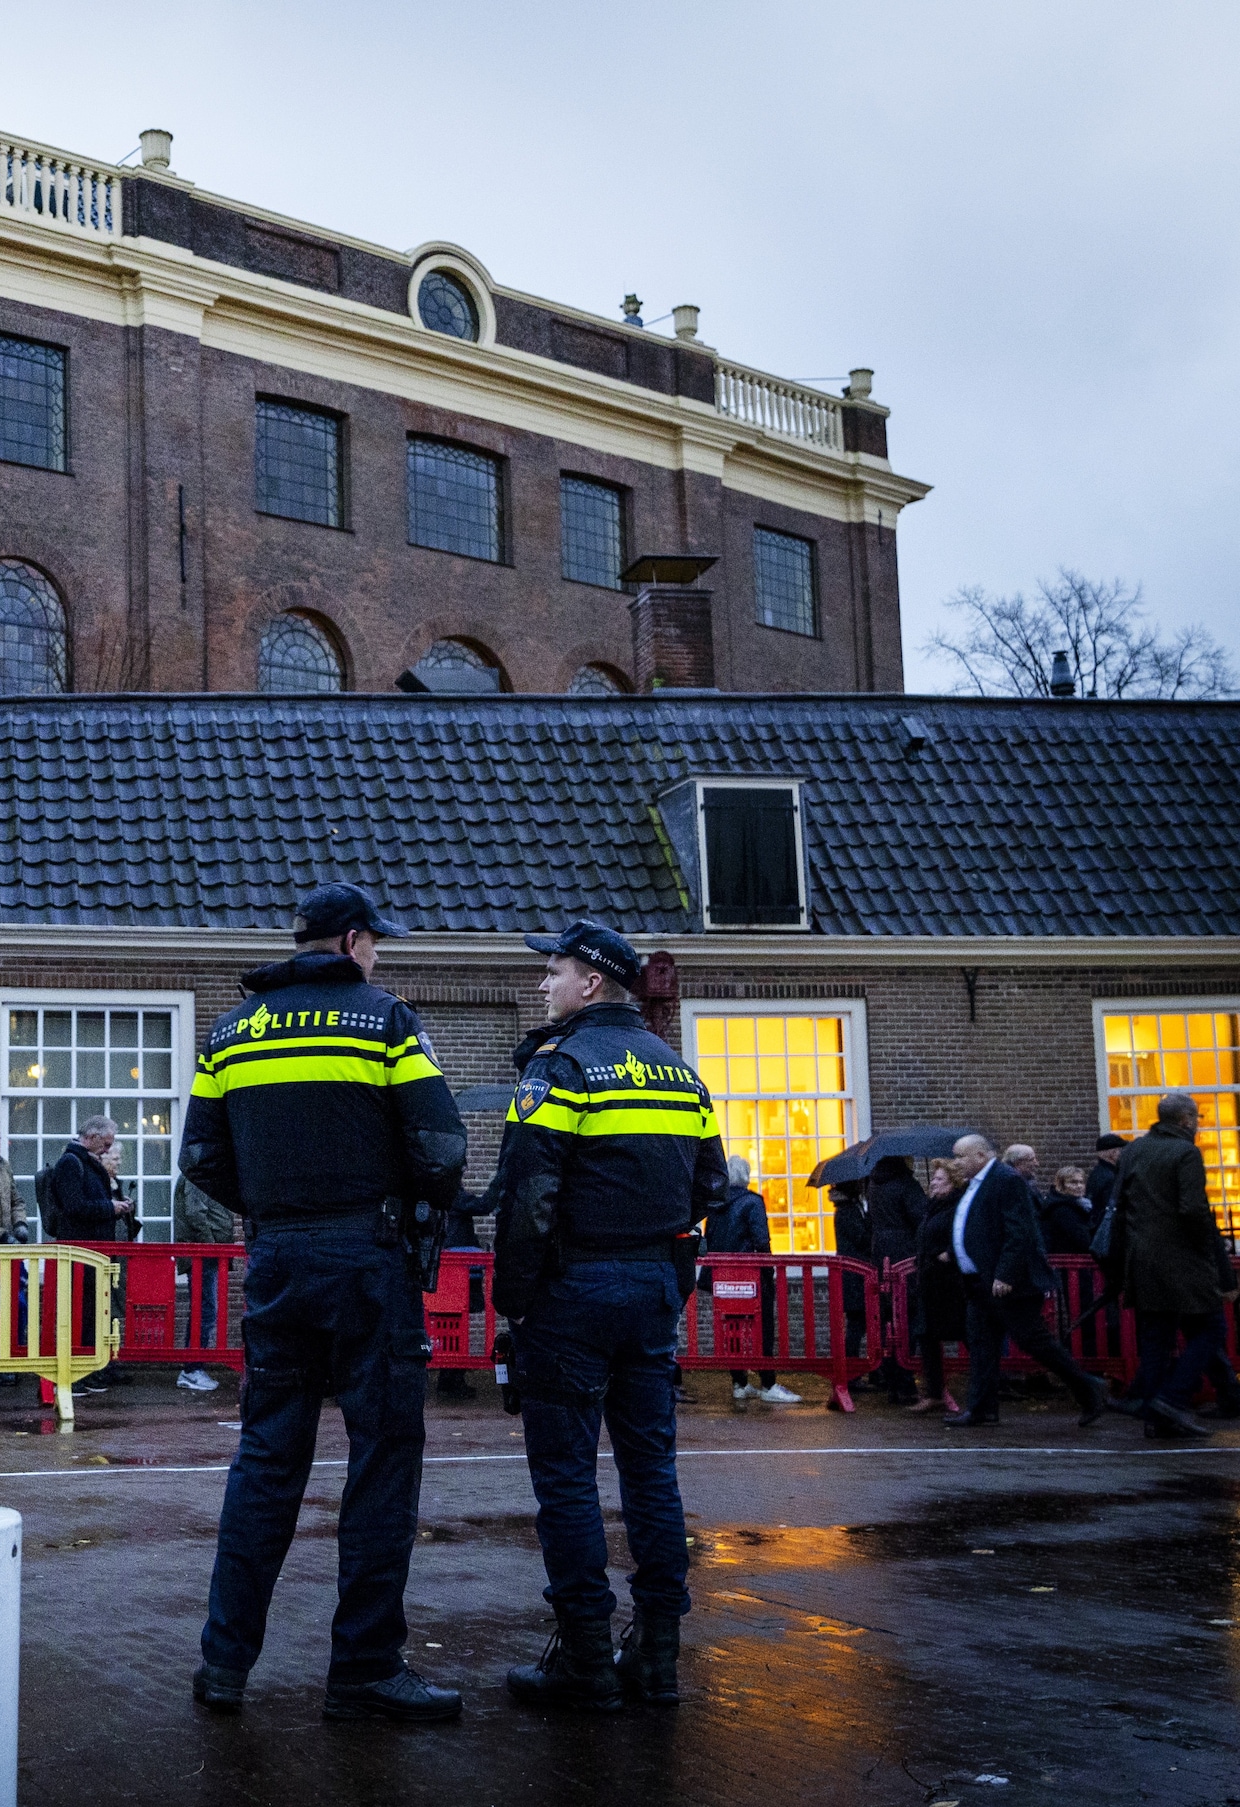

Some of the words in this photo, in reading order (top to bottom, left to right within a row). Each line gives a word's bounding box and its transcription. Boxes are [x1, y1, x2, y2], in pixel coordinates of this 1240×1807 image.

[588, 948, 620, 971] POLITIE
[236, 1003, 341, 1039] POLITIE
[614, 1050, 695, 1087] POLITIE
